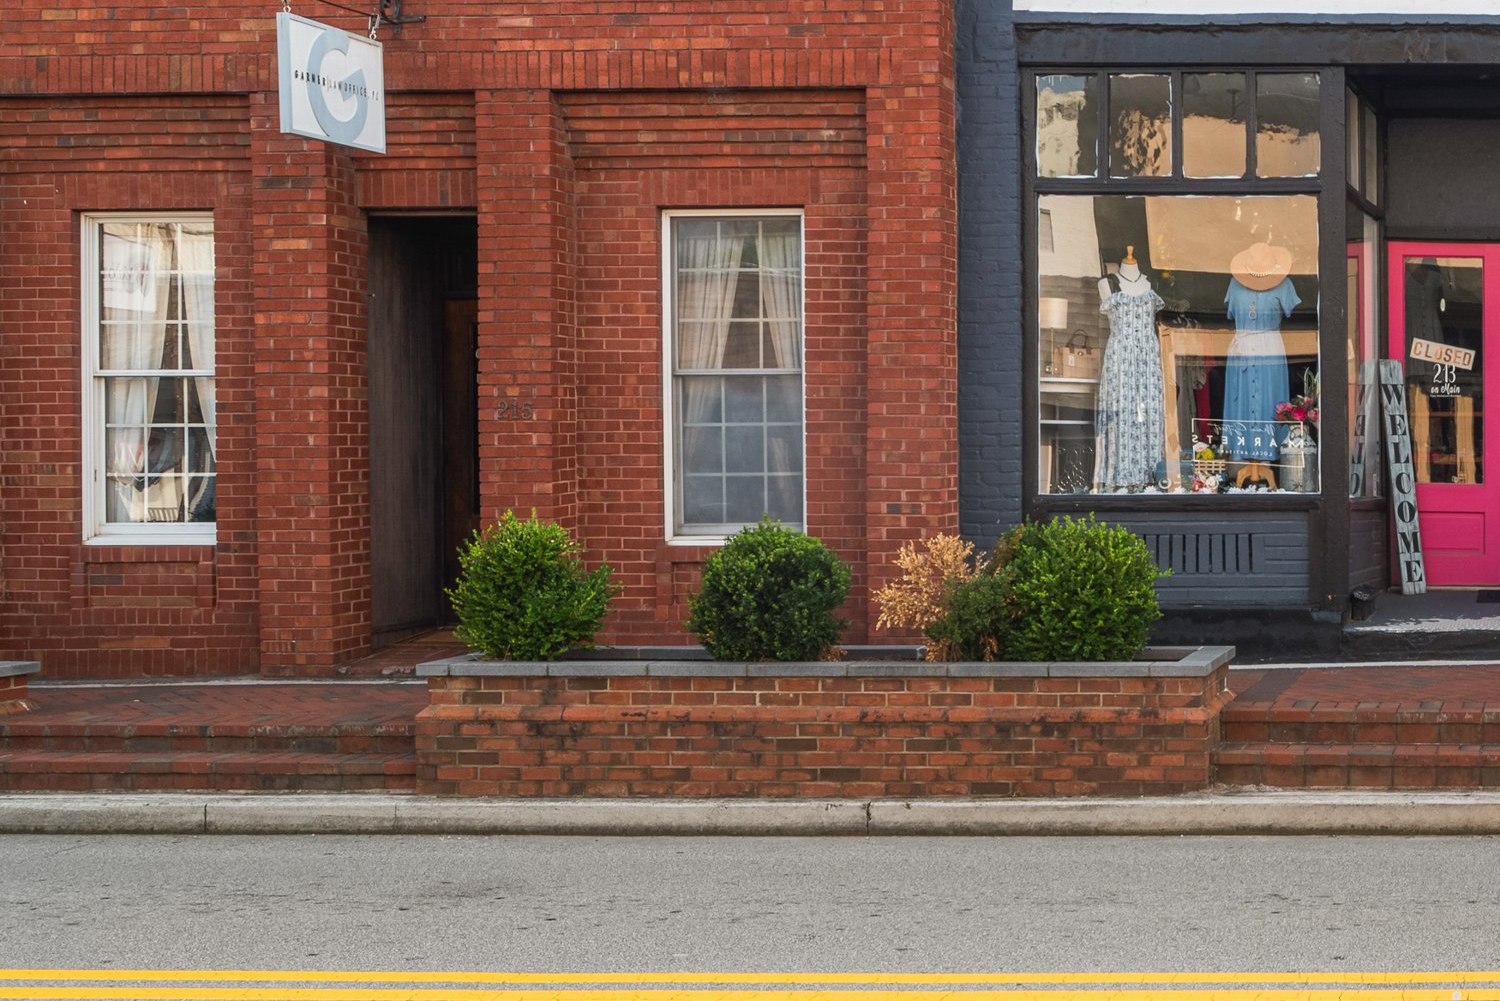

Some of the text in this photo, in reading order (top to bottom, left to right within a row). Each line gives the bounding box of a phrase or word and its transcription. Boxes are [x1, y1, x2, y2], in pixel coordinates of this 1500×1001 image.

[294, 69, 326, 86] GARNER
[1413, 341, 1472, 367] CLOSED
[1432, 363, 1456, 384] 213
[1430, 383, 1460, 395] on Main
[497, 398, 533, 420] 215
[1381, 383, 1423, 584] WELCOME
